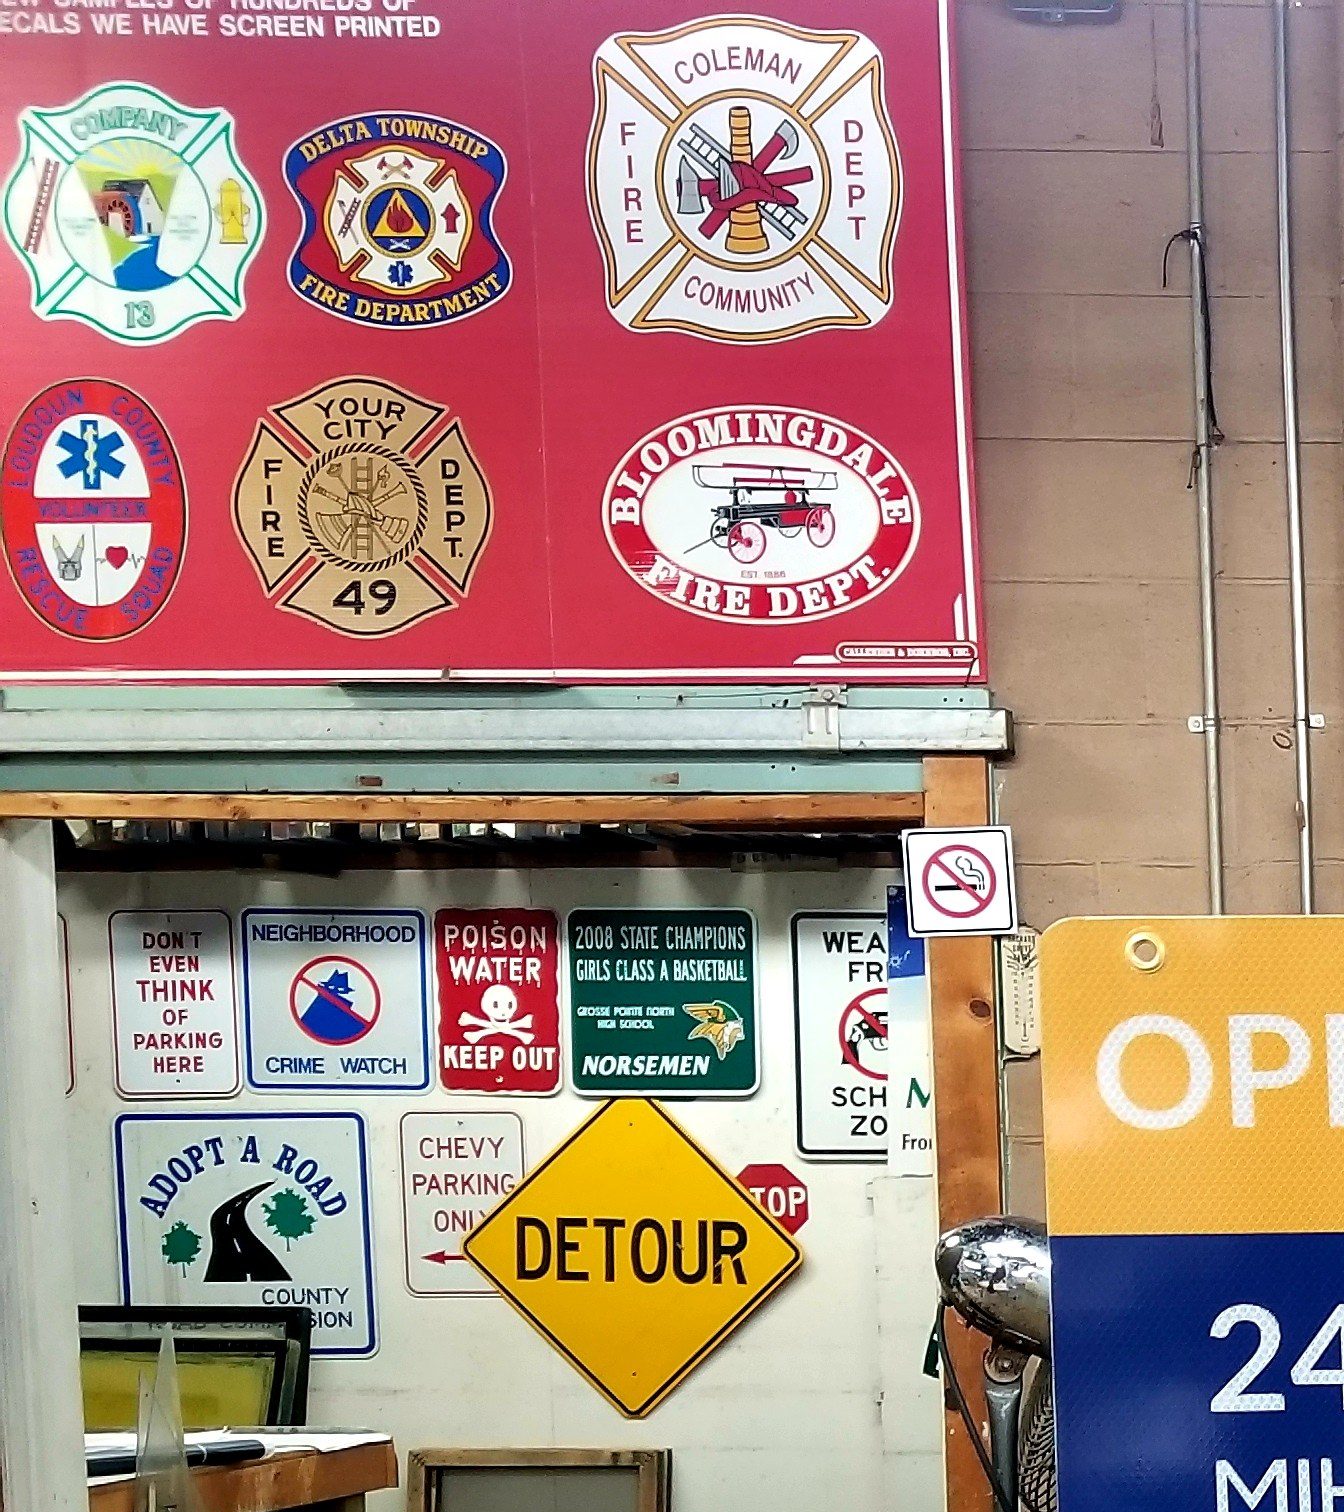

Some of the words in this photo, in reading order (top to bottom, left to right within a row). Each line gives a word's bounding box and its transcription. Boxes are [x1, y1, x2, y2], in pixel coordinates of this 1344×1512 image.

[0, 12, 81, 34] ECALS
[91, 13, 133, 35] WE
[142, 14, 209, 36] HAVE
[219, 14, 325, 37] SCREEN
[334, 15, 441, 37] PRINTED
[674, 46, 802, 85] COLEMAN
[70, 106, 188, 142] COMPANY
[299, 120, 371, 162] DELTA
[377, 118, 489, 160] TOWNSHIP
[620, 121, 644, 243] FIRE
[844, 120, 866, 240] DEPT
[300, 275, 350, 311] FIRE
[354, 273, 502, 322] DEPARTMENT
[684, 271, 815, 314] COMMUNITY
[124, 301, 156, 328] 13
[315, 397, 405, 422] YOUR
[9, 389, 84, 488] LOUDOUN
[110, 396, 174, 487] COUNTY
[324, 420, 397, 440] CITY
[611, 413, 911, 526] BLOOMINGDALE
[39, 501, 148, 518] VOLUNTEER
[261, 459, 286, 558] FIRE
[441, 459, 464, 558] DEPT.
[19, 547, 87, 630] RESCUE
[121, 547, 173, 621] SQUAD
[332, 580, 397, 615] 49
[645, 555, 750, 615] FIRE
[768, 555, 891, 616] DEPT.
[142, 931, 202, 949] DON'T
[252, 924, 416, 943] NEIGHBORHOOD
[444, 924, 547, 952] POISON
[575, 926, 614, 950] 2008
[619, 926, 661, 950] STATE
[665, 926, 746, 951] CHAMPIONS
[821, 931, 888, 953] WEA
[150, 955, 200, 973] EVEN
[449, 956, 541, 986] WATER
[576, 958, 610, 982] GIRLS
[615, 958, 655, 982] CLASS
[659, 958, 669, 981] A
[673, 958, 748, 982] BASKETBALL
[848, 961, 884, 983] FR
[135, 980, 215, 1002] THINK
[163, 1008, 188, 1026] OF
[133, 1033, 223, 1050] PARKING
[153, 1057, 204, 1074] HERE
[265, 1057, 325, 1074] CRIME
[340, 1057, 407, 1075] WATCH
[443, 1045, 505, 1071] KEEP
[512, 1046, 556, 1071] OUT
[582, 1055, 710, 1076] NORSEMEN
[831, 1086, 887, 1108] SCH
[851, 1116, 888, 1137] ZO
[419, 1137, 505, 1159] CHEVY
[139, 1137, 225, 1219] ADOPT
[240, 1136, 261, 1163] A
[273, 1144, 348, 1217] ROAD
[412, 1174, 515, 1196] PARKING
[750, 1187, 806, 1217] TOP
[516, 1217, 748, 1285] DETOUR
[262, 1288, 349, 1305] COUNTY
